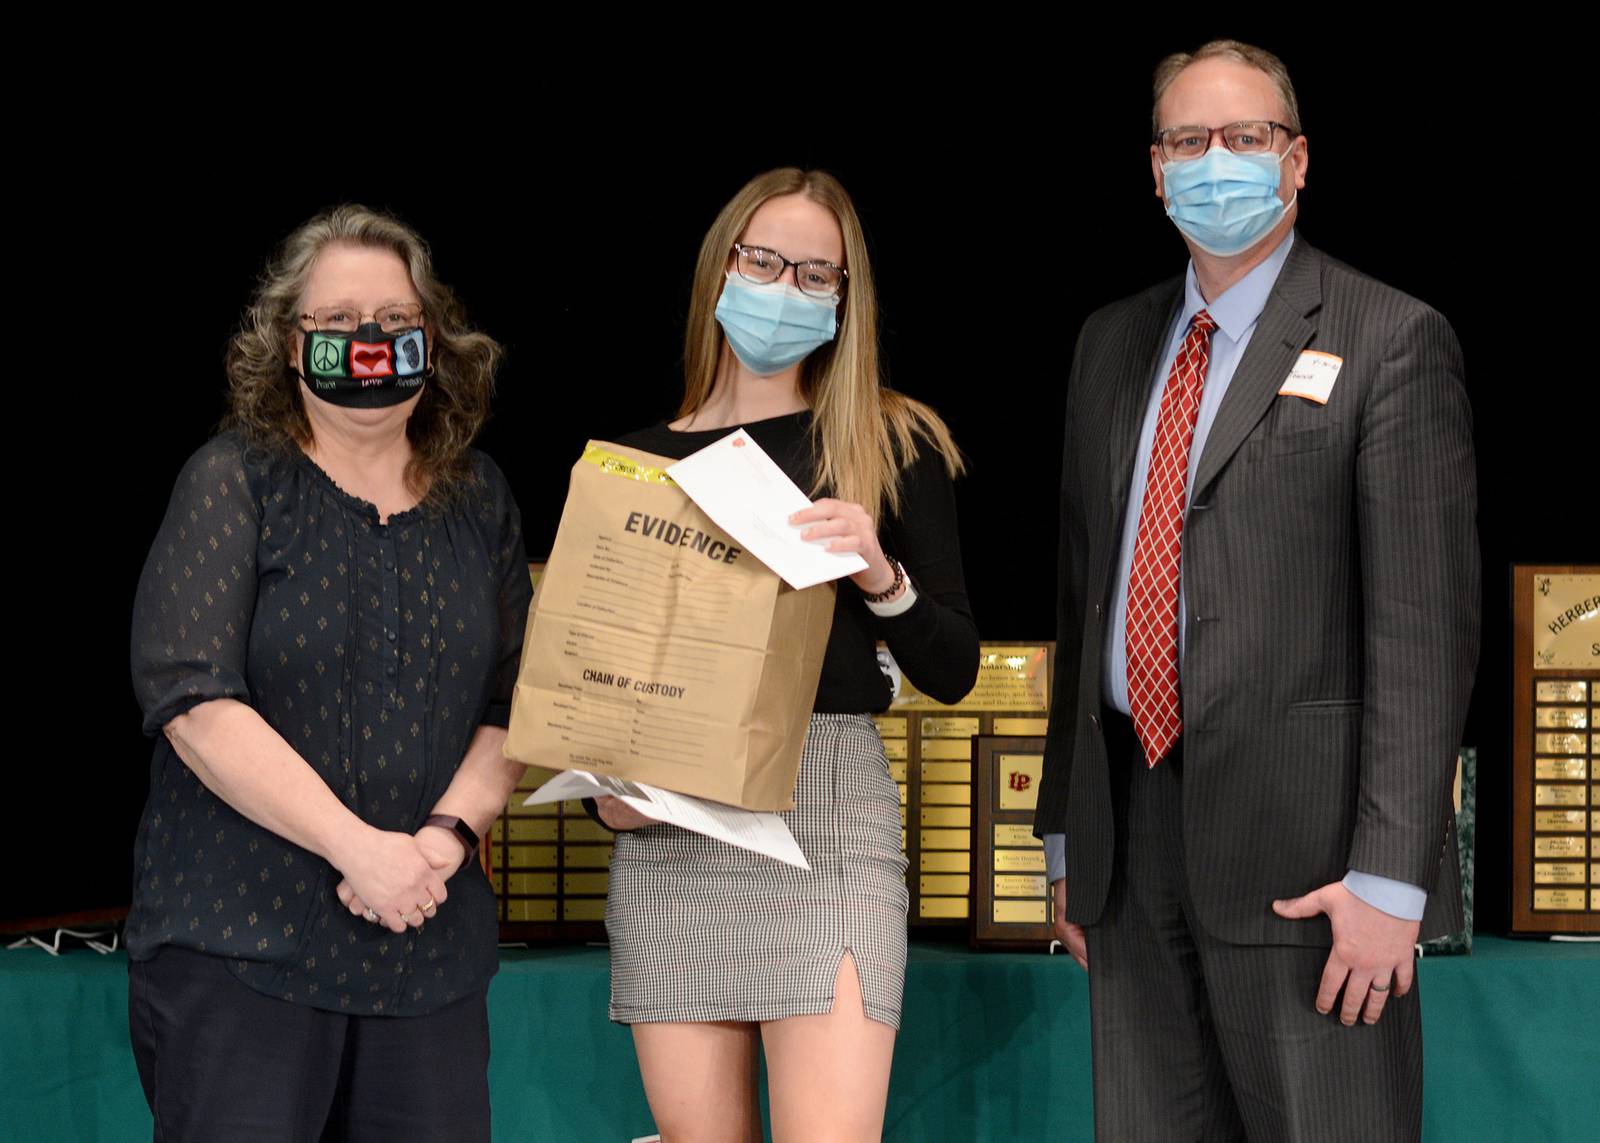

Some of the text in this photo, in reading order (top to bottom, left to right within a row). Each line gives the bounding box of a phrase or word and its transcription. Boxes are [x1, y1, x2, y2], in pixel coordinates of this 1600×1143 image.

[624, 511, 742, 565] EVIDENCE
[583, 669, 686, 699] CHAIN OF CUSTODY
